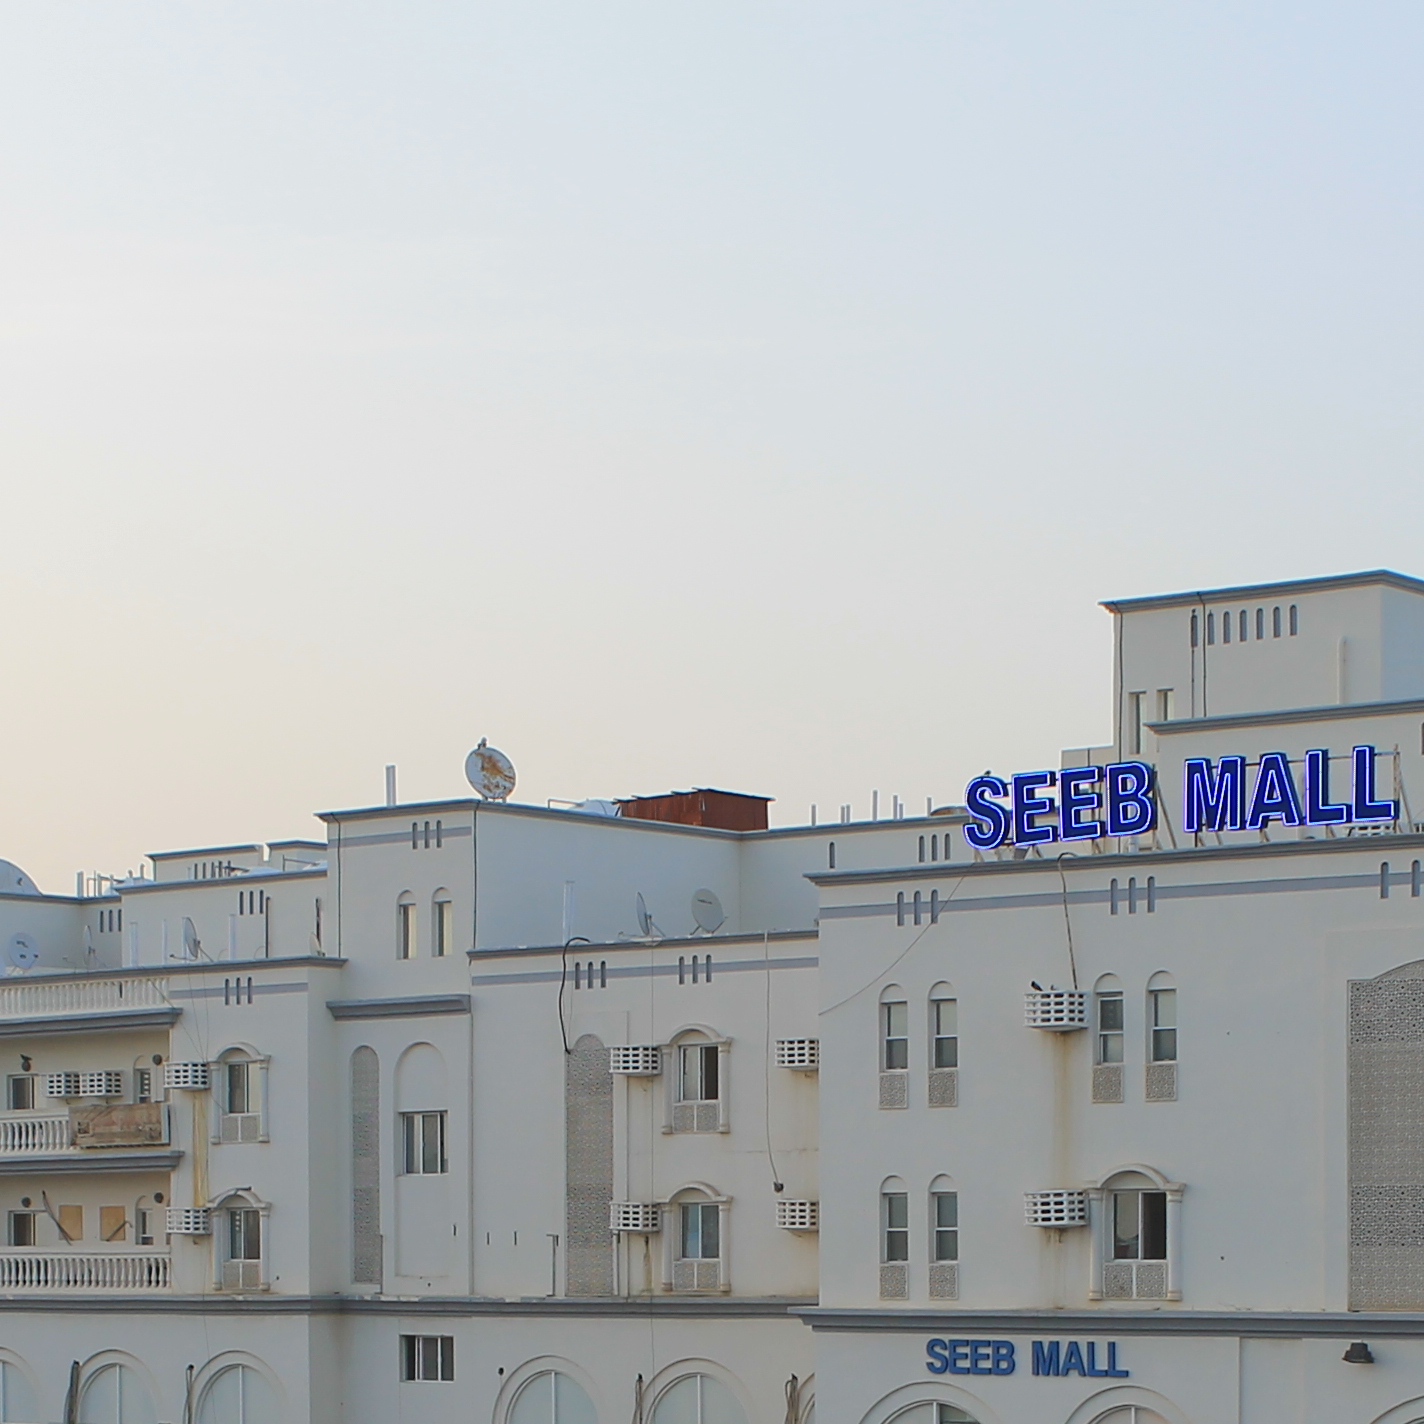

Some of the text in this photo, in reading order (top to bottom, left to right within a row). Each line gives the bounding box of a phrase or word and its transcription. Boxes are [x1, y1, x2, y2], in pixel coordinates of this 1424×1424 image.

[963, 745, 1398, 850] SEEB MALL
[926, 1338, 1129, 1378] SEEB MALL
